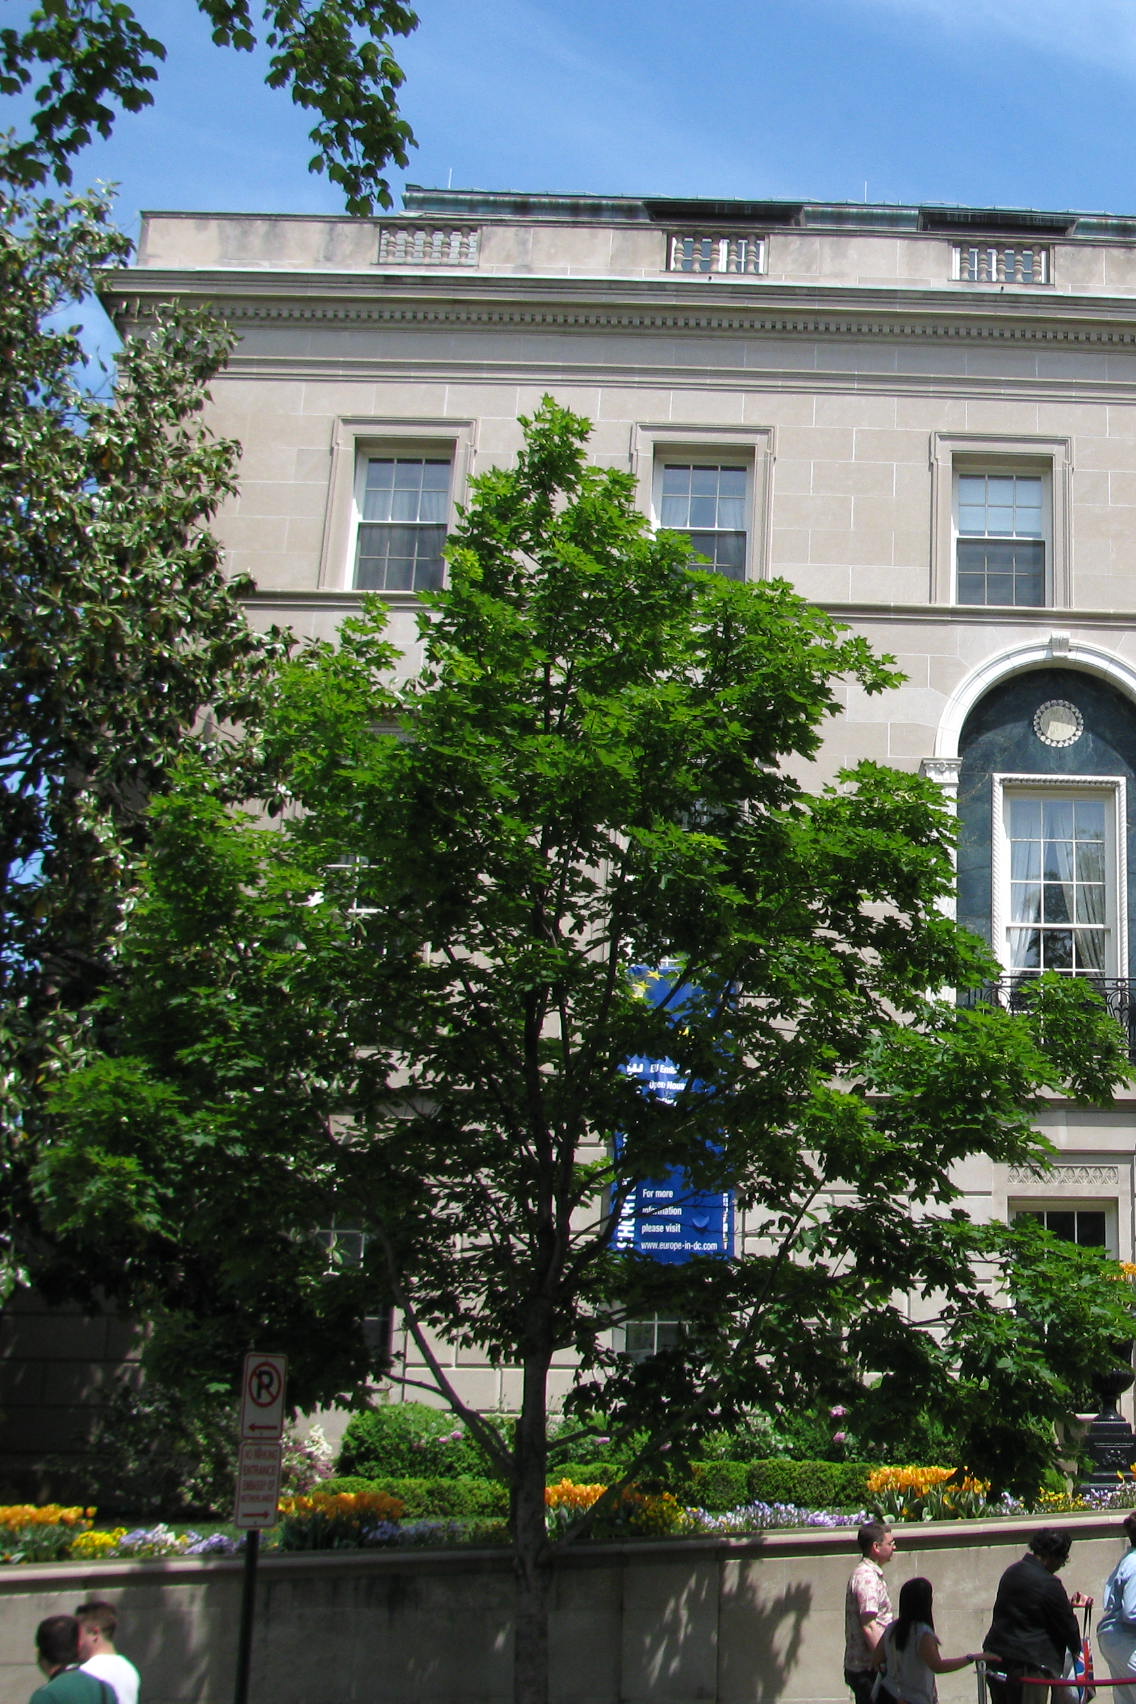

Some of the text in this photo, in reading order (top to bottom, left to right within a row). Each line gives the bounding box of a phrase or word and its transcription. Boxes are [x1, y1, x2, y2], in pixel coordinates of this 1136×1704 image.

[642, 1189, 673, 1198] For more
[641, 1223, 681, 1234] please visit
[641, 1241, 717, 1251] www.europe-in-dc.com
